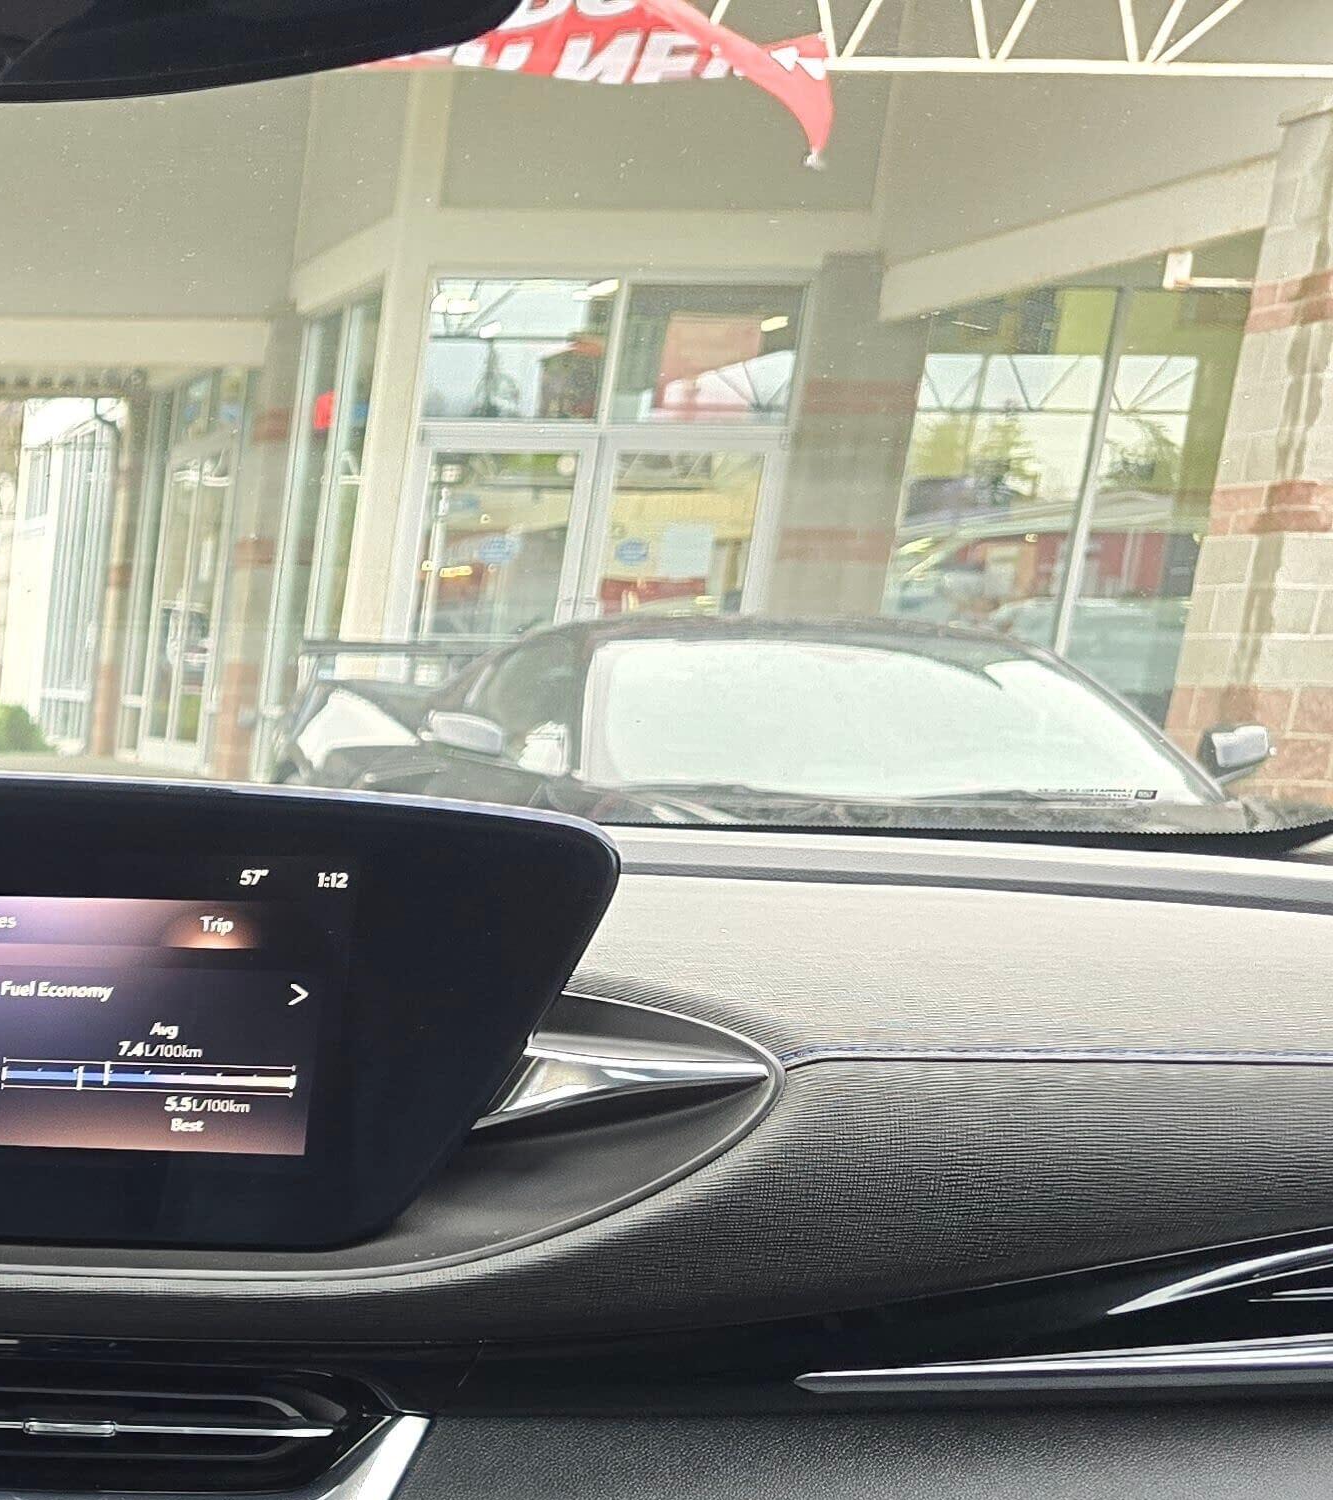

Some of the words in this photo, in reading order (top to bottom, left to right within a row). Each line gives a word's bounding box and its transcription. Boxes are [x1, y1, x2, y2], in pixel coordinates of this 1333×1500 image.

[317, 872, 349, 889] 1:12
[199, 915, 234, 937] Trip
[0, 980, 36, 997] Fuel
[36, 981, 114, 1003] Economy
[149, 1021, 179, 1040] Avg
[170, 1117, 204, 1132] Best
